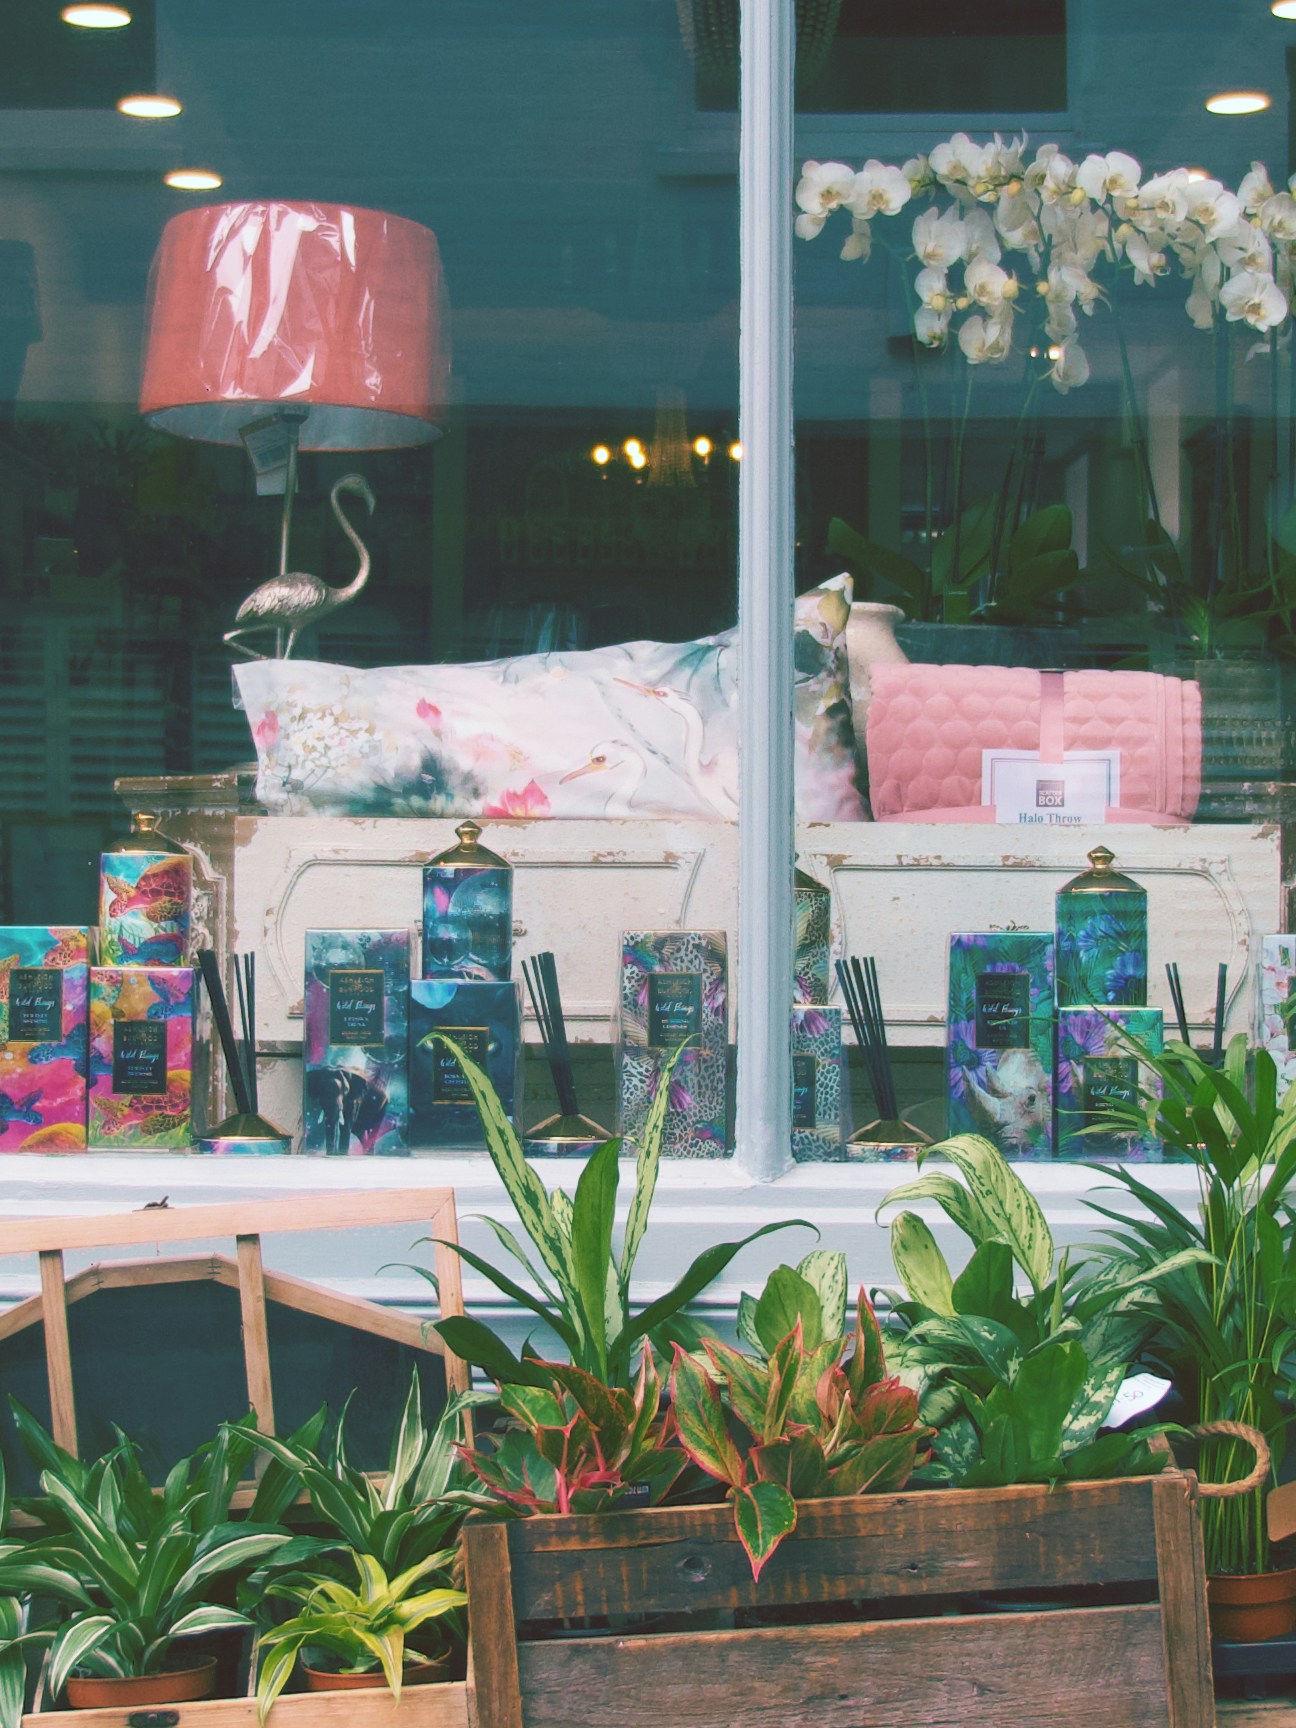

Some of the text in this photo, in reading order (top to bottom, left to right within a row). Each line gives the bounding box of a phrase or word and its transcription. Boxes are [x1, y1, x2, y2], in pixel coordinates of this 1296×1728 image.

[1038, 796, 1063, 805] BOX
[1019, 812, 1082, 823] Halo Throw
